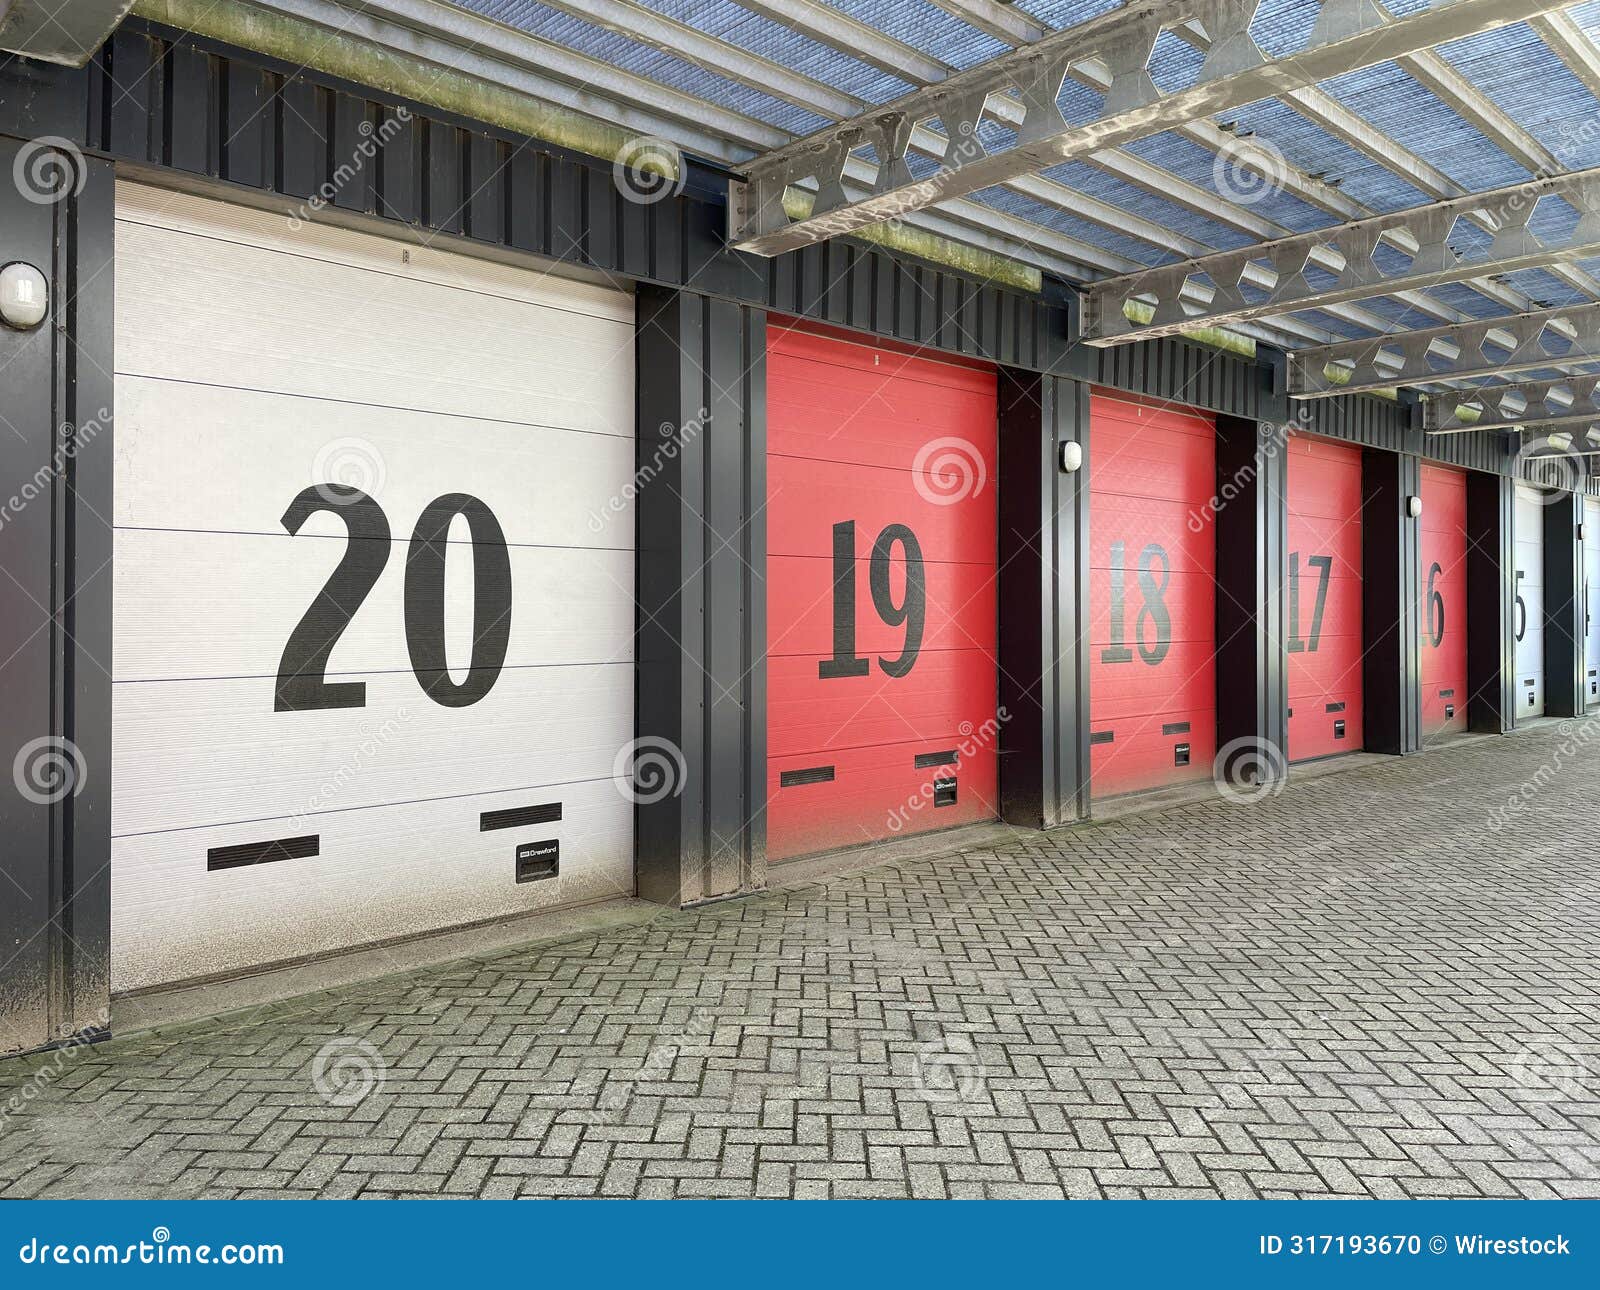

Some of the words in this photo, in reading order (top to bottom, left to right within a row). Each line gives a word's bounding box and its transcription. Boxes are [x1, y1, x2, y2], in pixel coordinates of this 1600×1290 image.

[274, 483, 512, 712] 20
[819, 520, 926, 679] 19
[1102, 541, 1171, 665] 18
[1288, 551, 1333, 653] 17
[1420, 562, 1444, 648] 6
